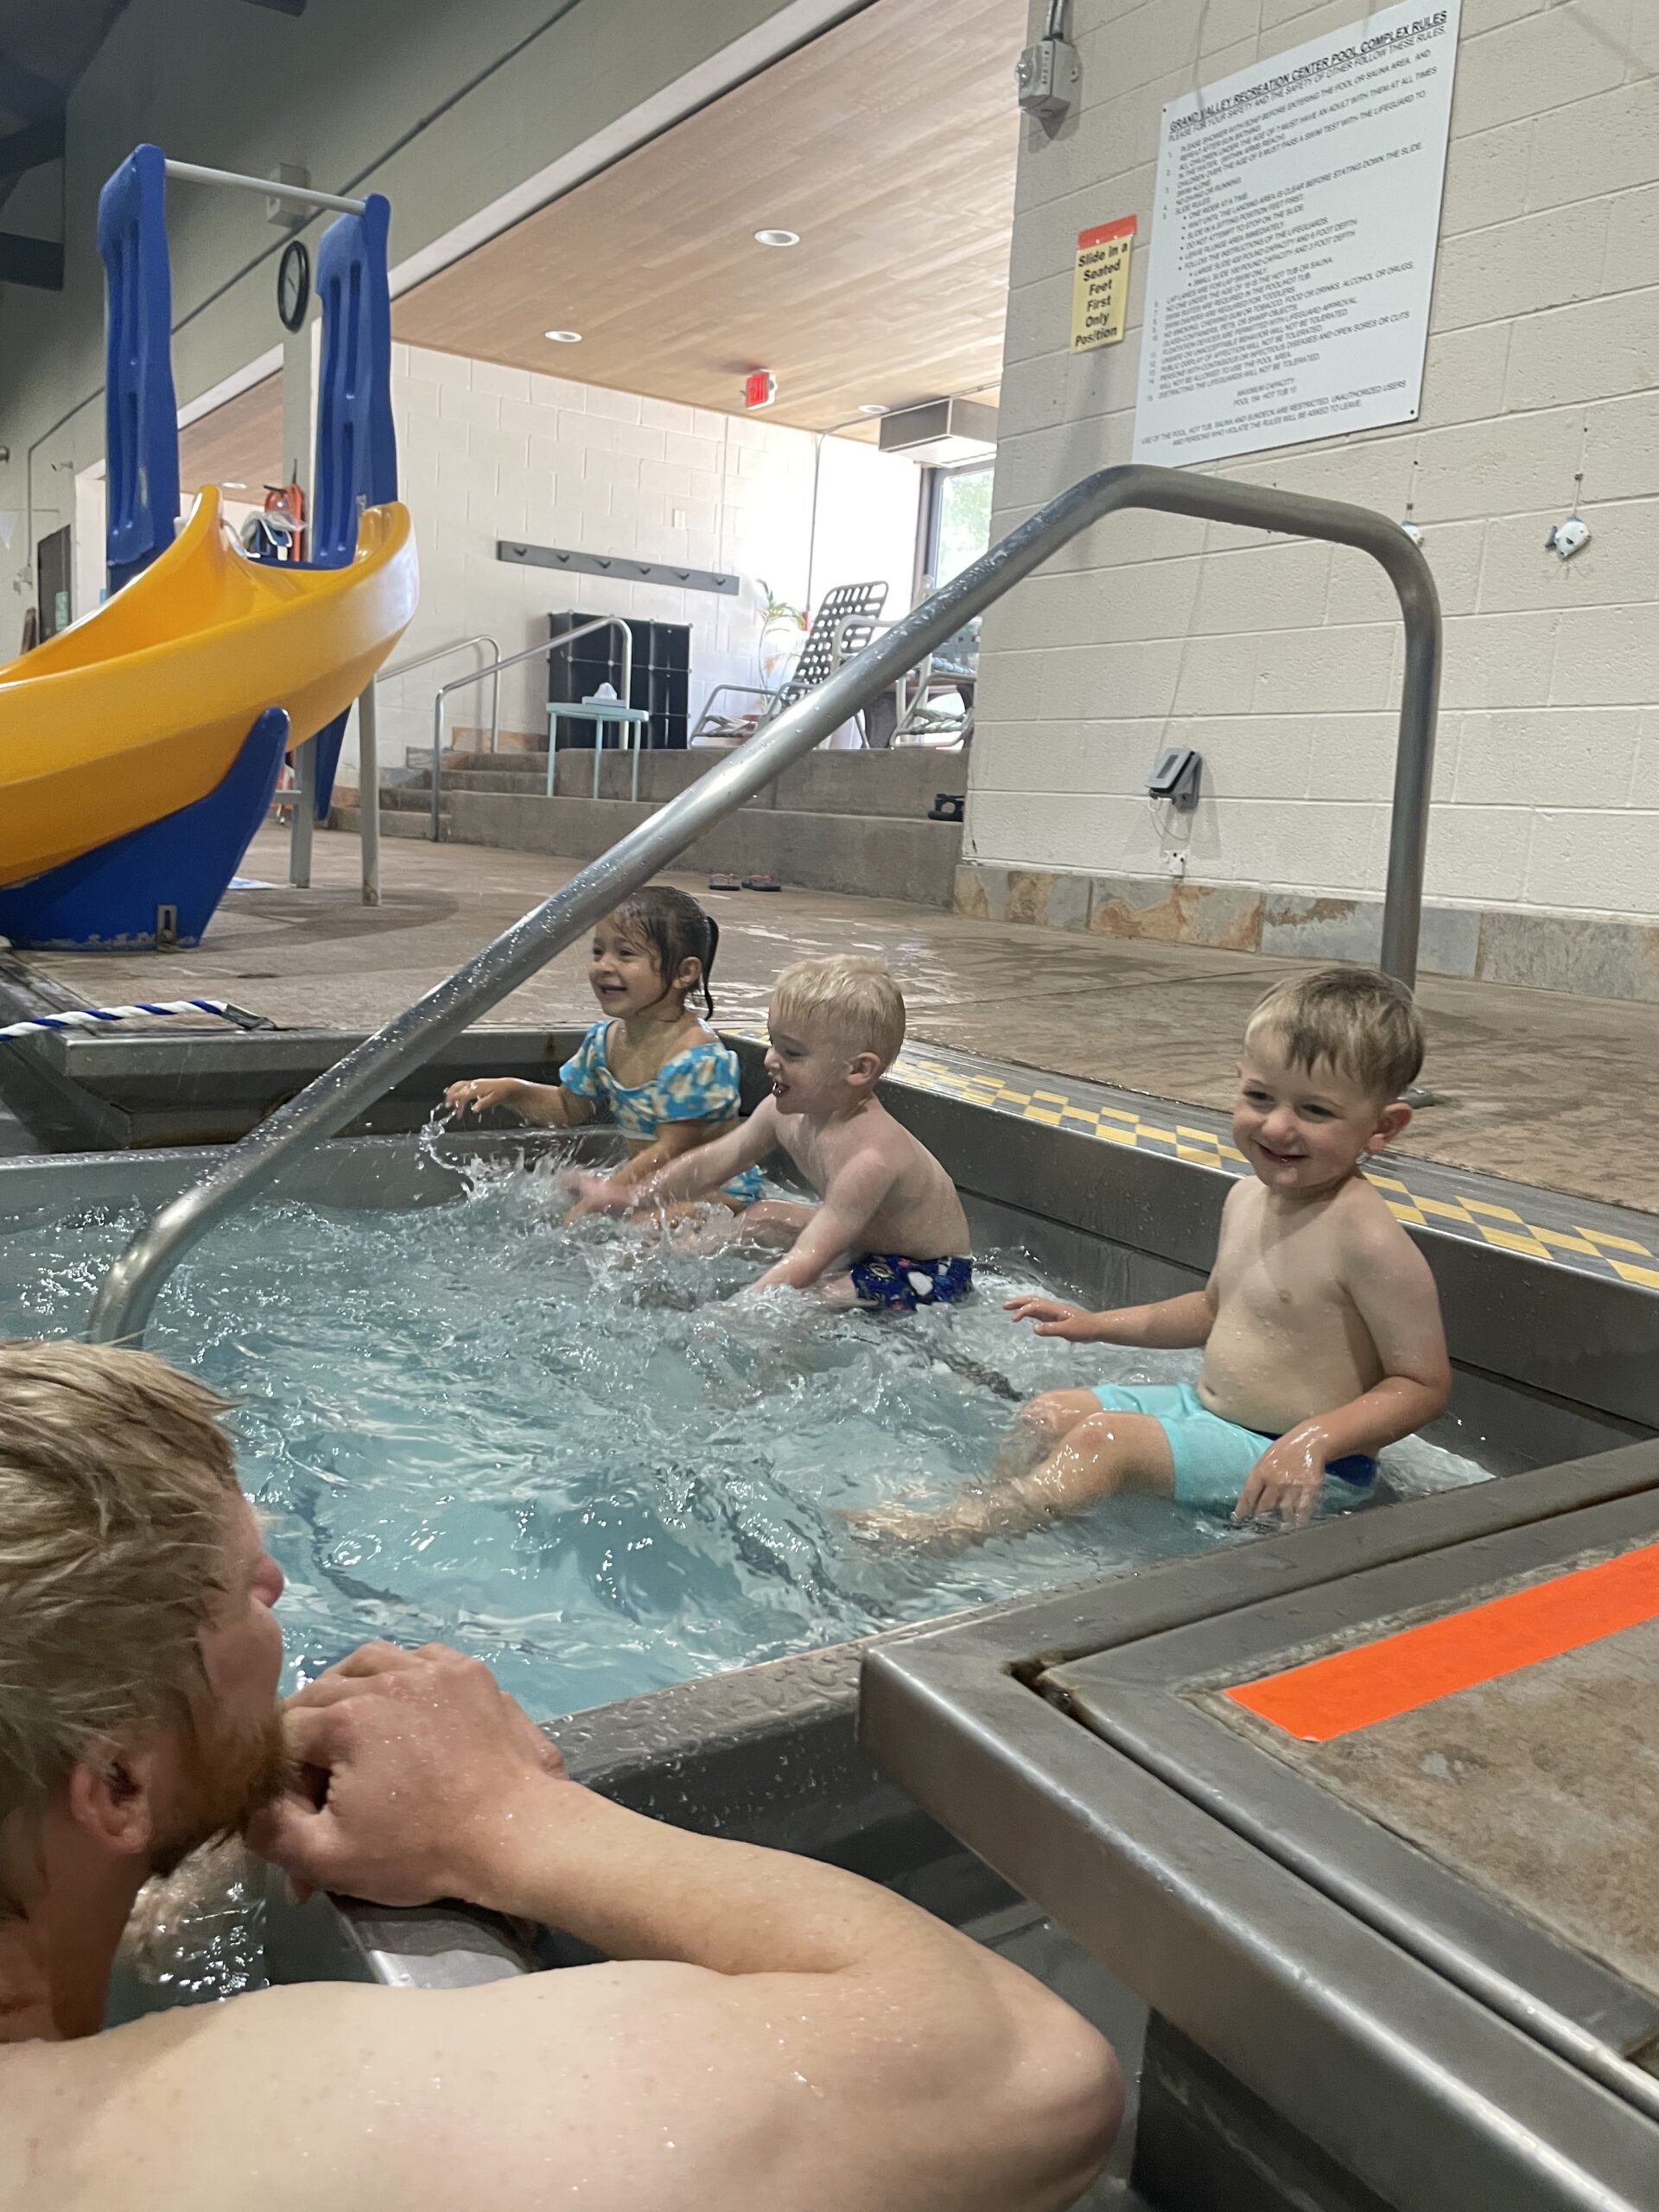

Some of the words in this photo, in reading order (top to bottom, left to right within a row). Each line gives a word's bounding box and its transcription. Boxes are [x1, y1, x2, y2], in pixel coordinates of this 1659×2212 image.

[1168, 111, 1198, 132] GRAND
[1078, 251, 1105, 267] Slide
[1109, 245, 1118, 257] in
[1122, 243, 1128, 252] a
[1083, 259, 1121, 282] Seated
[1089, 279, 1112, 296] Feet
[1086, 296, 1111, 312] First
[1085, 312, 1109, 327] Only
[1075, 327, 1117, 346] Position
